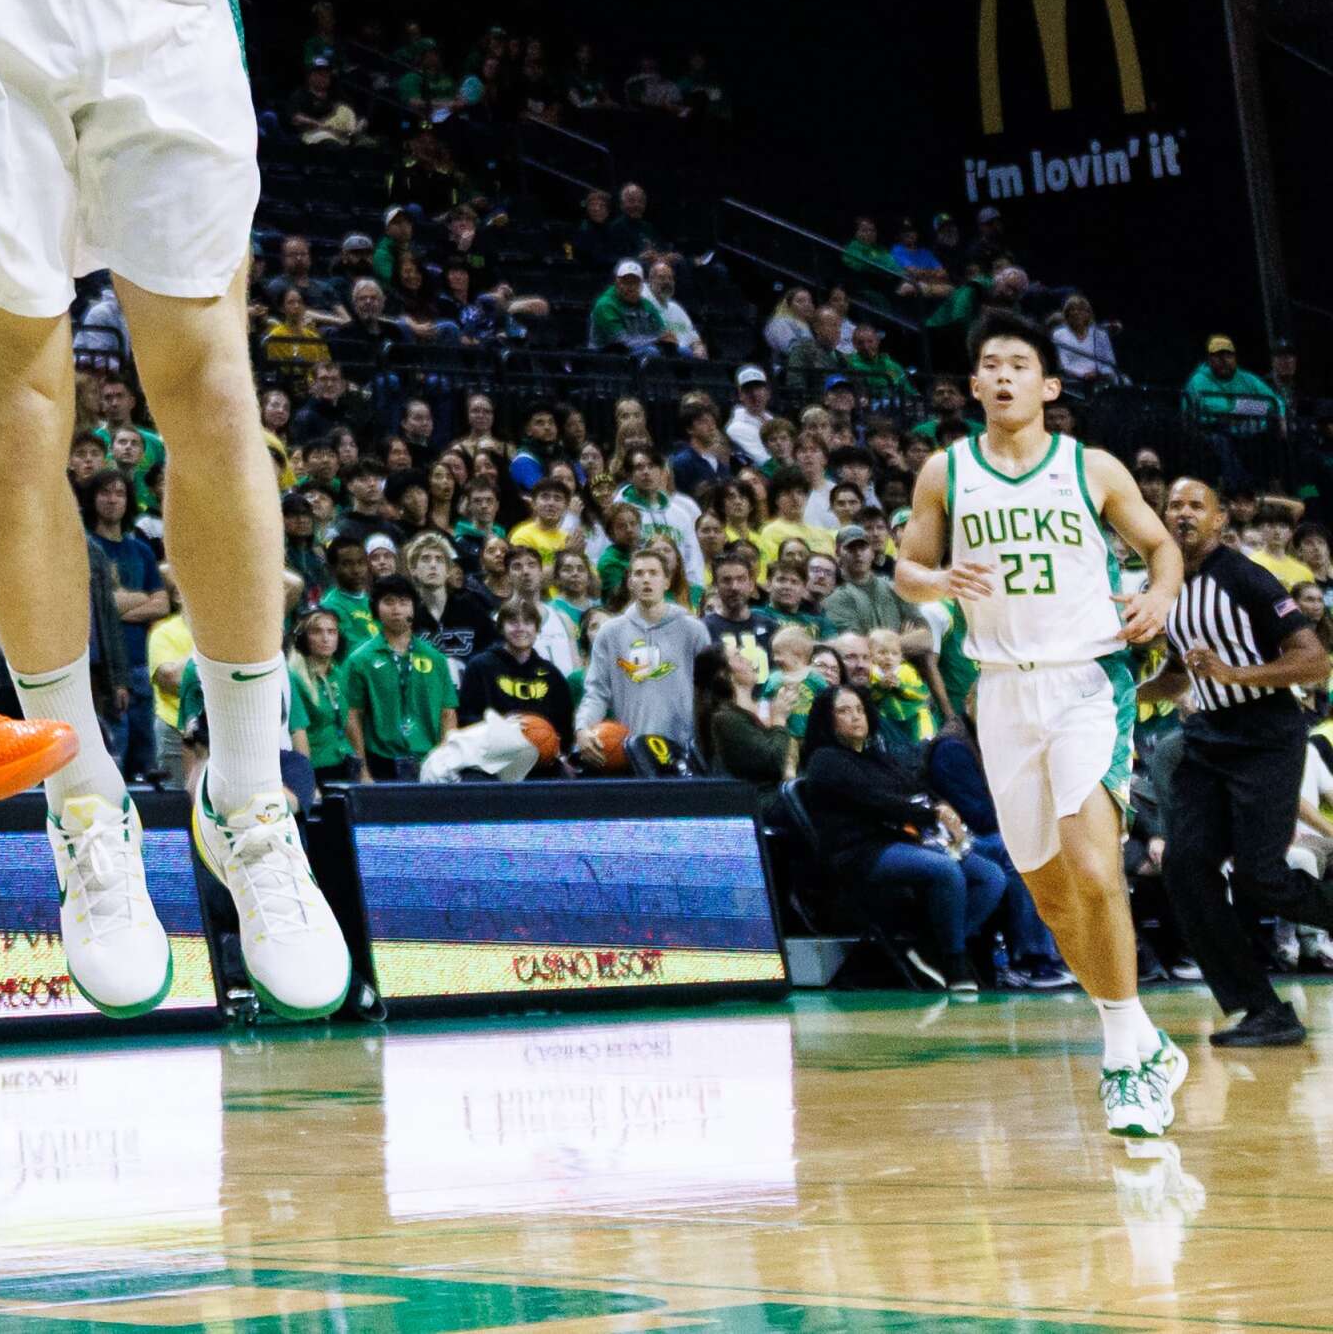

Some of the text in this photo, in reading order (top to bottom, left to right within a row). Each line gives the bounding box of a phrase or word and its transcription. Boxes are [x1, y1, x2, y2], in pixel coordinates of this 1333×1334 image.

[964, 131, 1182, 203] i'm lovin' it
[961, 507, 1083, 550] DUCKS
[999, 553, 1057, 596] 23
